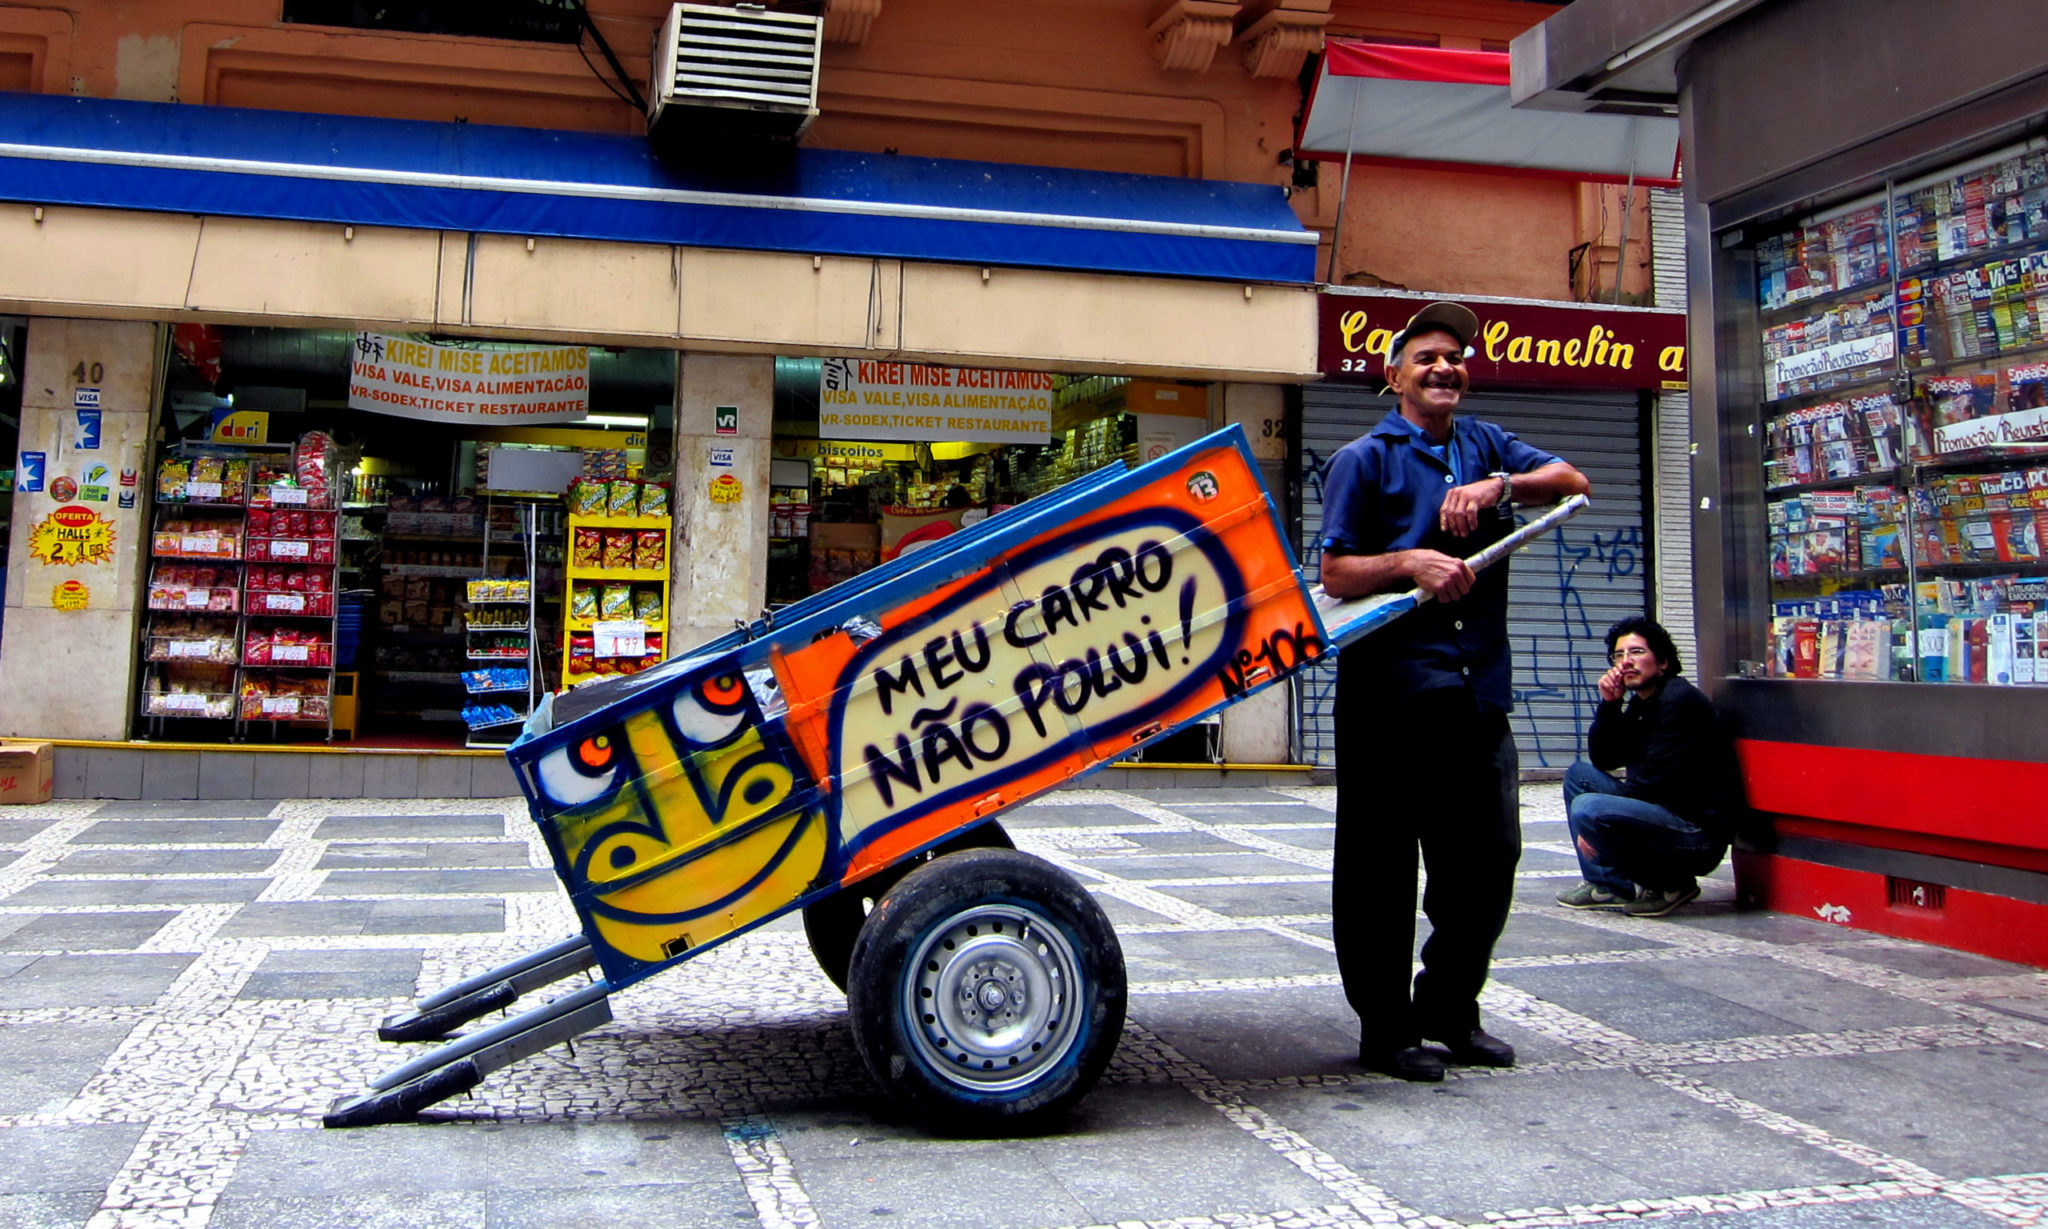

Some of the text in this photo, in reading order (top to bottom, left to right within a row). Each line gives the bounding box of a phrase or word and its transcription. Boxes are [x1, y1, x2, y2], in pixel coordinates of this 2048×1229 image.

[386, 337, 433, 369] KIREI
[439, 350, 483, 375] MISE
[488, 346, 588, 375] ACEITAMOS
[1341, 359, 1367, 372] 32
[1821, 343, 1869, 371] Revistas
[72, 361, 104, 384] 40
[352, 361, 386, 382] VISA
[857, 360, 905, 385] KIREI
[910, 363, 951, 388] MISE
[956, 367, 1053, 391] ACEITAMOS
[77, 394, 98, 402] VISA
[480, 399, 588, 415] RESTAURANTE.
[822, 389, 858, 405] VISA
[221, 418, 259, 438] dori
[947, 416, 1051, 433] RESTAURANTE.
[1262, 418, 1285, 438] 32
[818, 443, 884, 458] biscoitos
[1190, 478, 1218, 503] 13
[55, 512, 94, 521] OFERTA
[57, 528, 91, 540] HALLS
[50, 542, 64, 561] 2
[873, 539, 1173, 716] MEU CARRO
[863, 696, 1011, 808] NÃO
